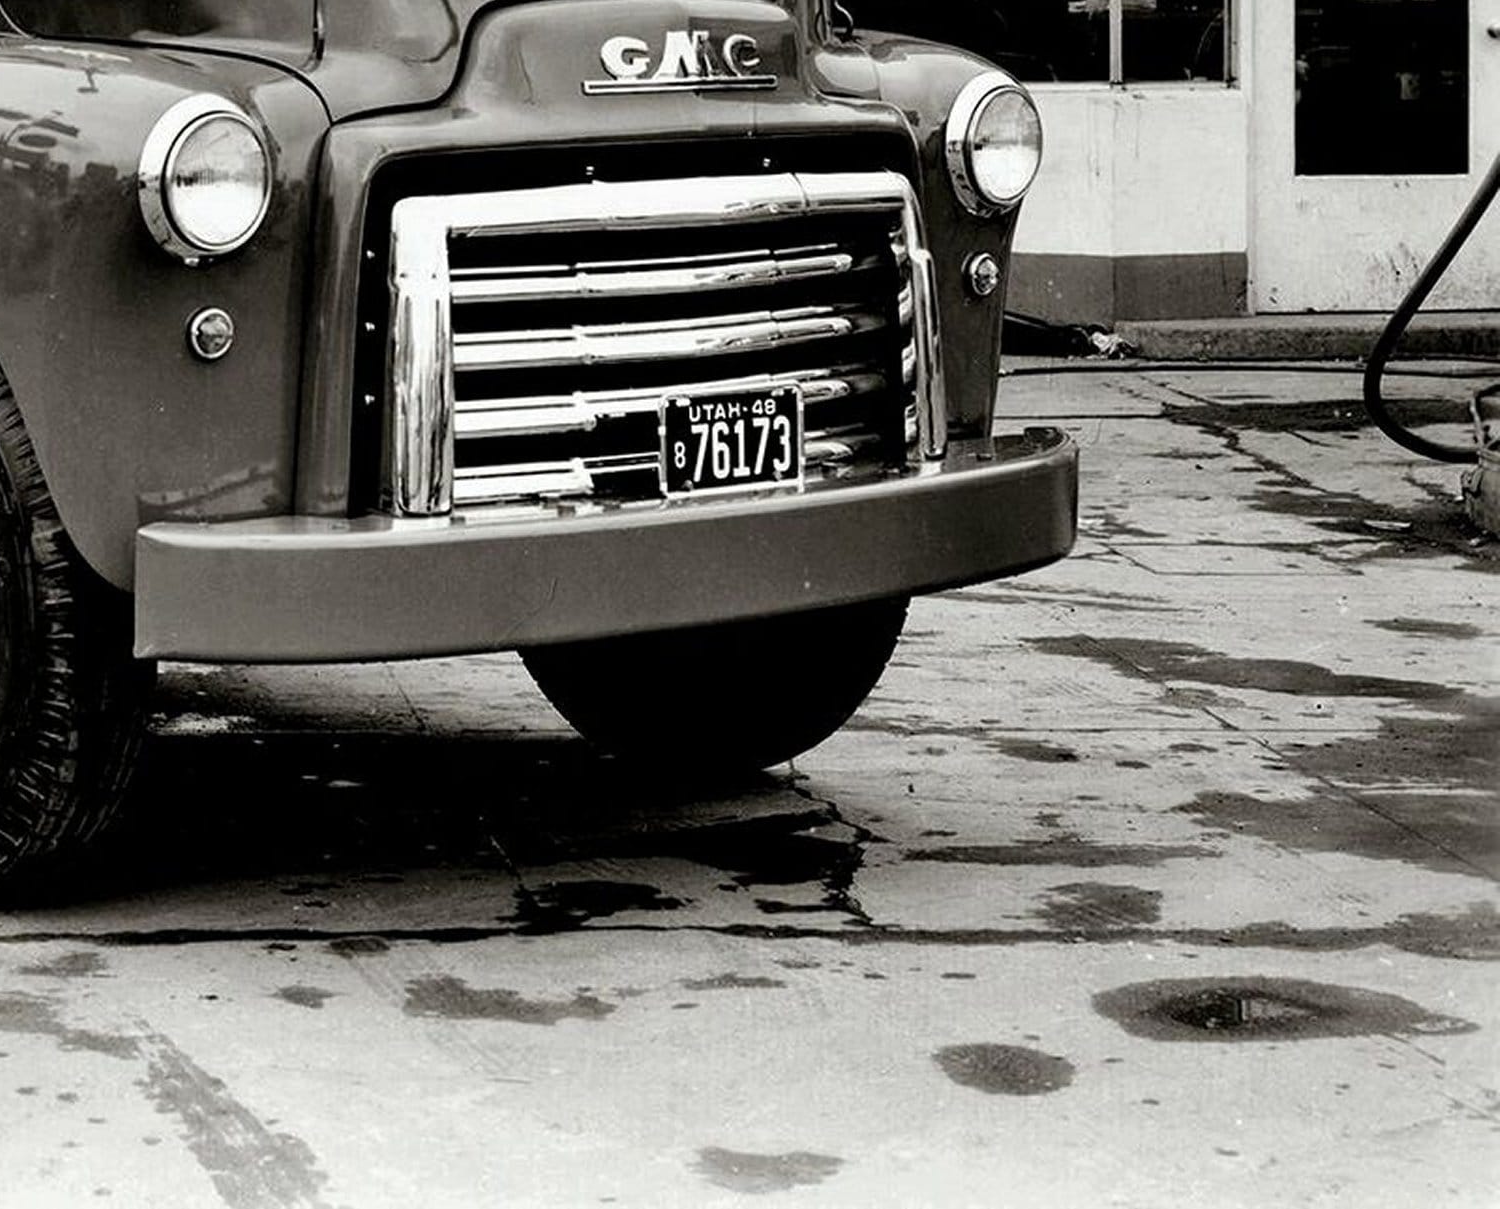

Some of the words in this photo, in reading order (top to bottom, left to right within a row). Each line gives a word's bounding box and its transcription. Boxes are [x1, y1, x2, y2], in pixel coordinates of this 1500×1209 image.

[600, 30, 761, 80] GMC
[673, 441, 687, 470] 8
[690, 414, 792, 483] 76173
